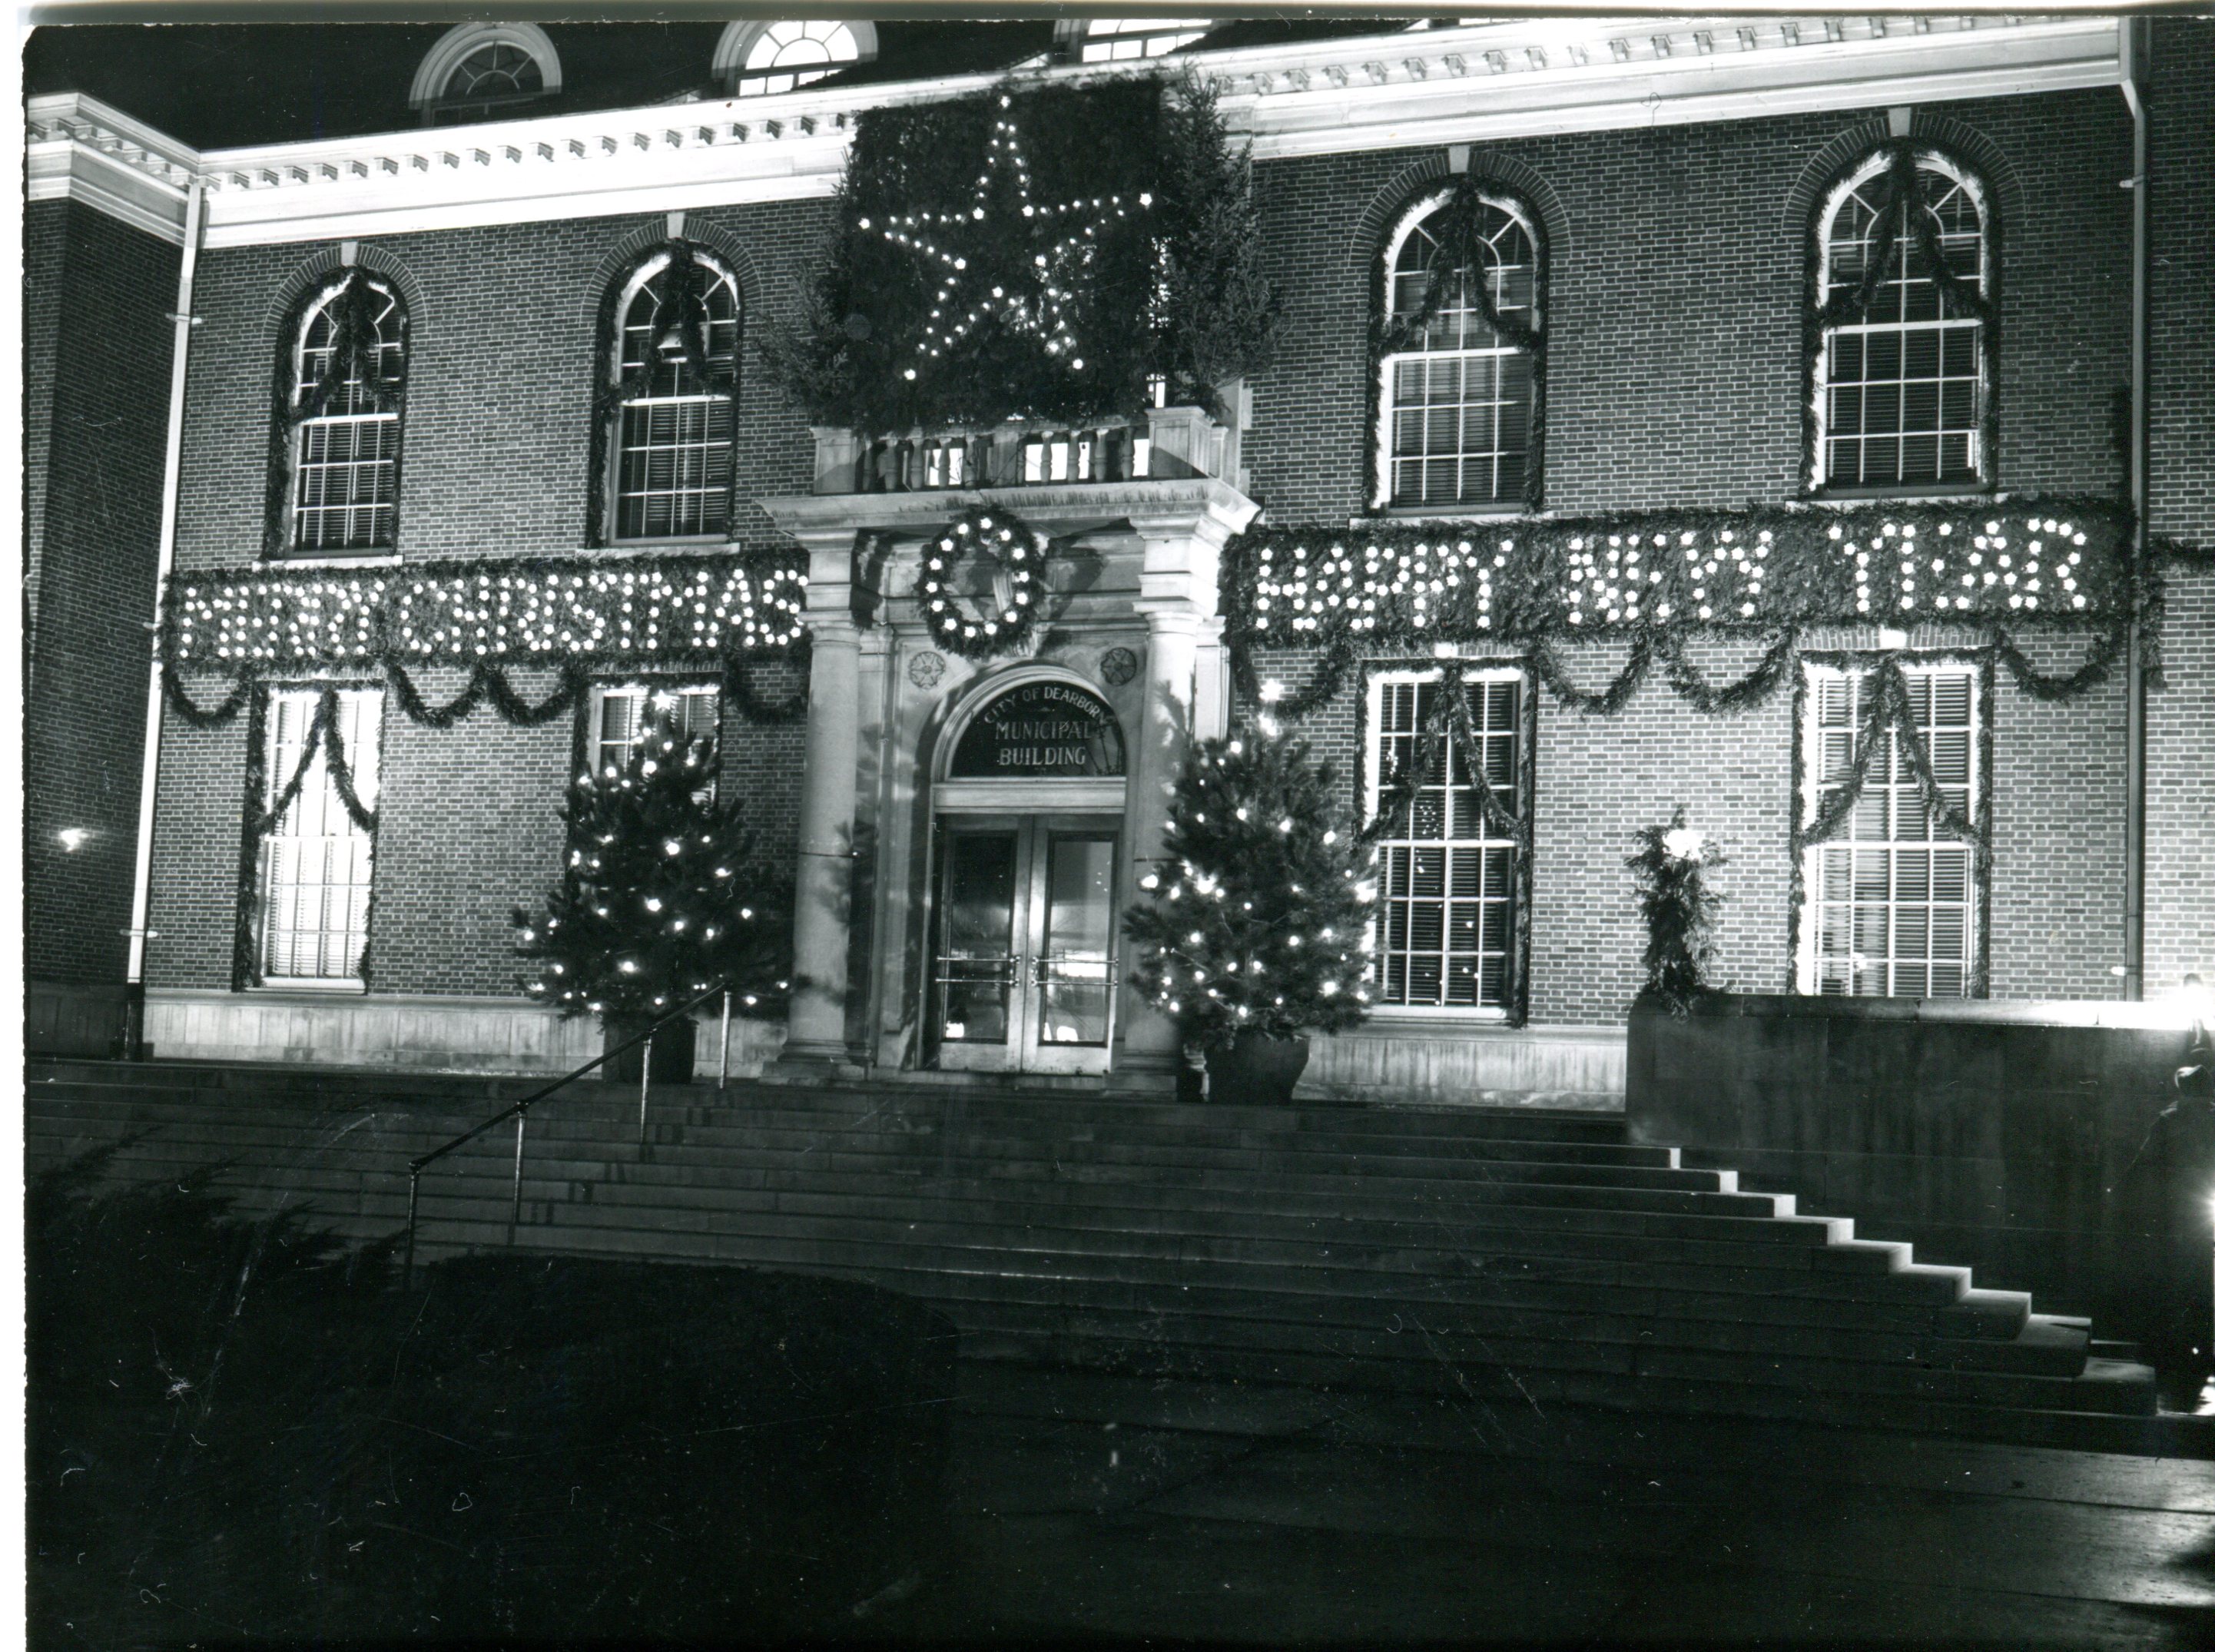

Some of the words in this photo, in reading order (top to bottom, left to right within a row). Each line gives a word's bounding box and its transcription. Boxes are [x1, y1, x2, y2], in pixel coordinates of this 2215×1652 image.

[1257, 539, 1514, 629] HAPPY
[1568, 529, 1774, 628] NEW
[1829, 518, 2087, 613] YEAR
[181, 581, 385, 658] MERRY
[401, 569, 808, 655] CHRISTMAS
[984, 695, 1016, 724] CITY
[1023, 688, 1040, 701] OF
[1045, 686, 1109, 725] DEARBORN
[996, 722, 1091, 739] MUNICIPAL
[1000, 747, 1086, 765] BUILDING
